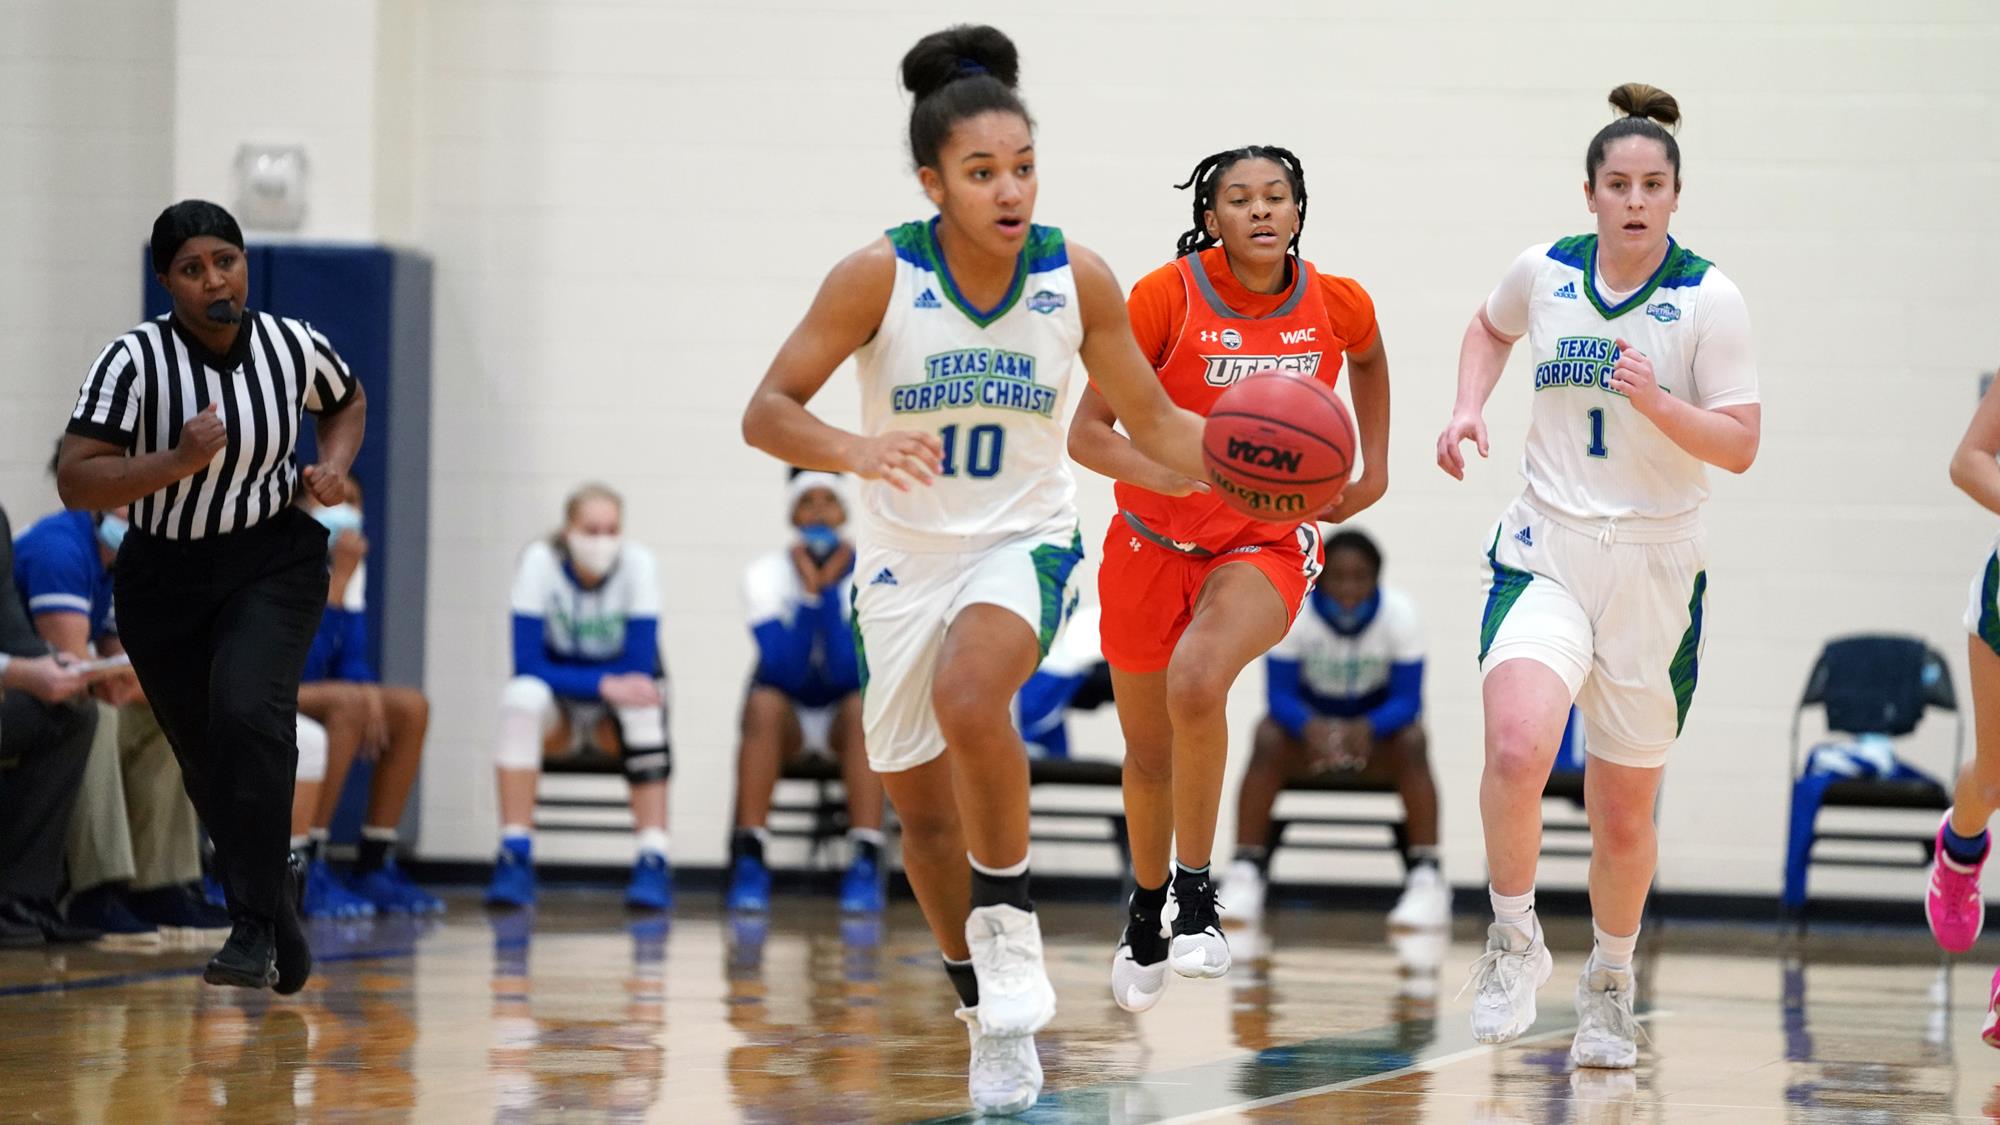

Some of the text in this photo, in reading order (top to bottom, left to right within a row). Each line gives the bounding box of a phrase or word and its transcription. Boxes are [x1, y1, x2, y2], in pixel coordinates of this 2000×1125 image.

[1280, 328, 1317, 345] WAC
[1558, 338, 1608, 361] TEXAS
[928, 351, 1032, 380] TEXAS A&M
[1535, 361, 1596, 389] CORPUS
[893, 380, 975, 412] CORPUS
[1587, 406, 1608, 459] 1
[938, 423, 1005, 479] 10
[1228, 436, 1303, 473] NCAA
